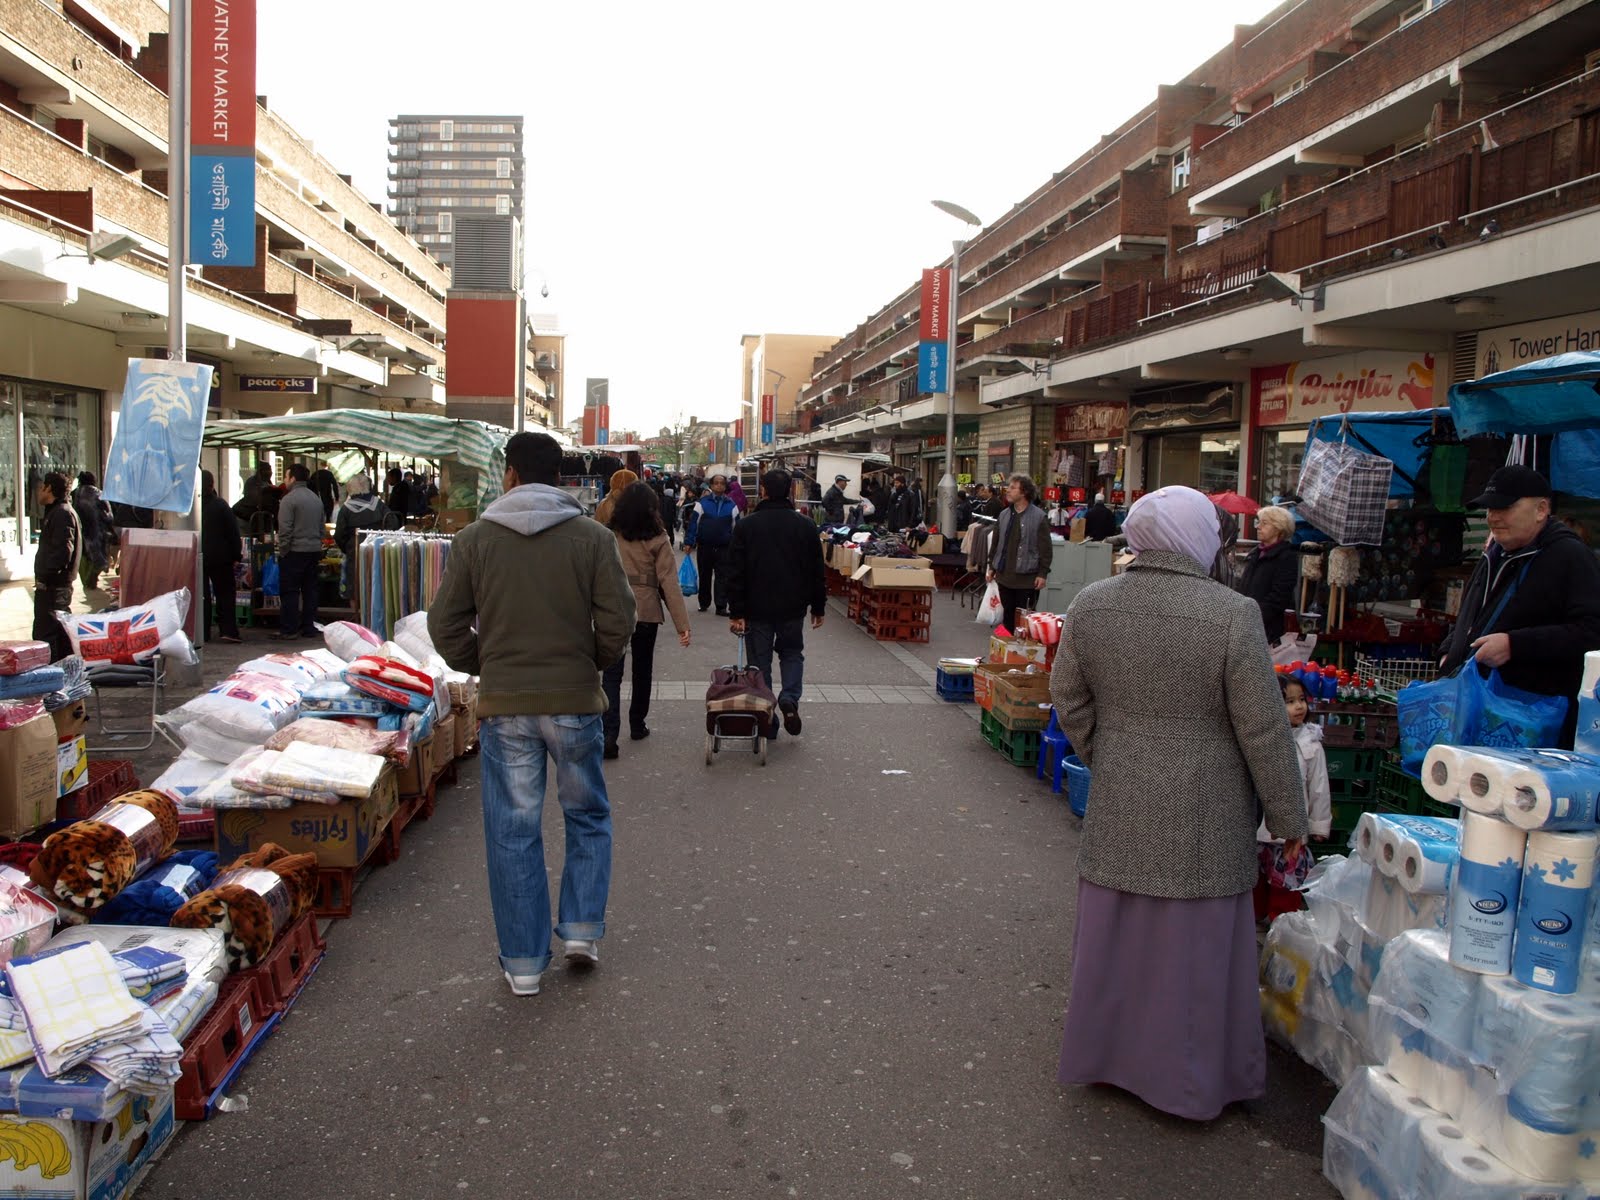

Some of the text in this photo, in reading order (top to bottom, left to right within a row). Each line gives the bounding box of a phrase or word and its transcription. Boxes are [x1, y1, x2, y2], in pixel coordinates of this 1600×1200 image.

[213, 0, 229, 142] ATNEY MARKET
[930, 269, 941, 339] WATNEY MARKET
[1509, 335, 1563, 359] Tower
[247, 378, 305, 389] peacocks
[1300, 369, 1393, 413] Brigita
[1477, 900, 1500, 909] NICKY
[1540, 919, 1563, 928] NICKY
